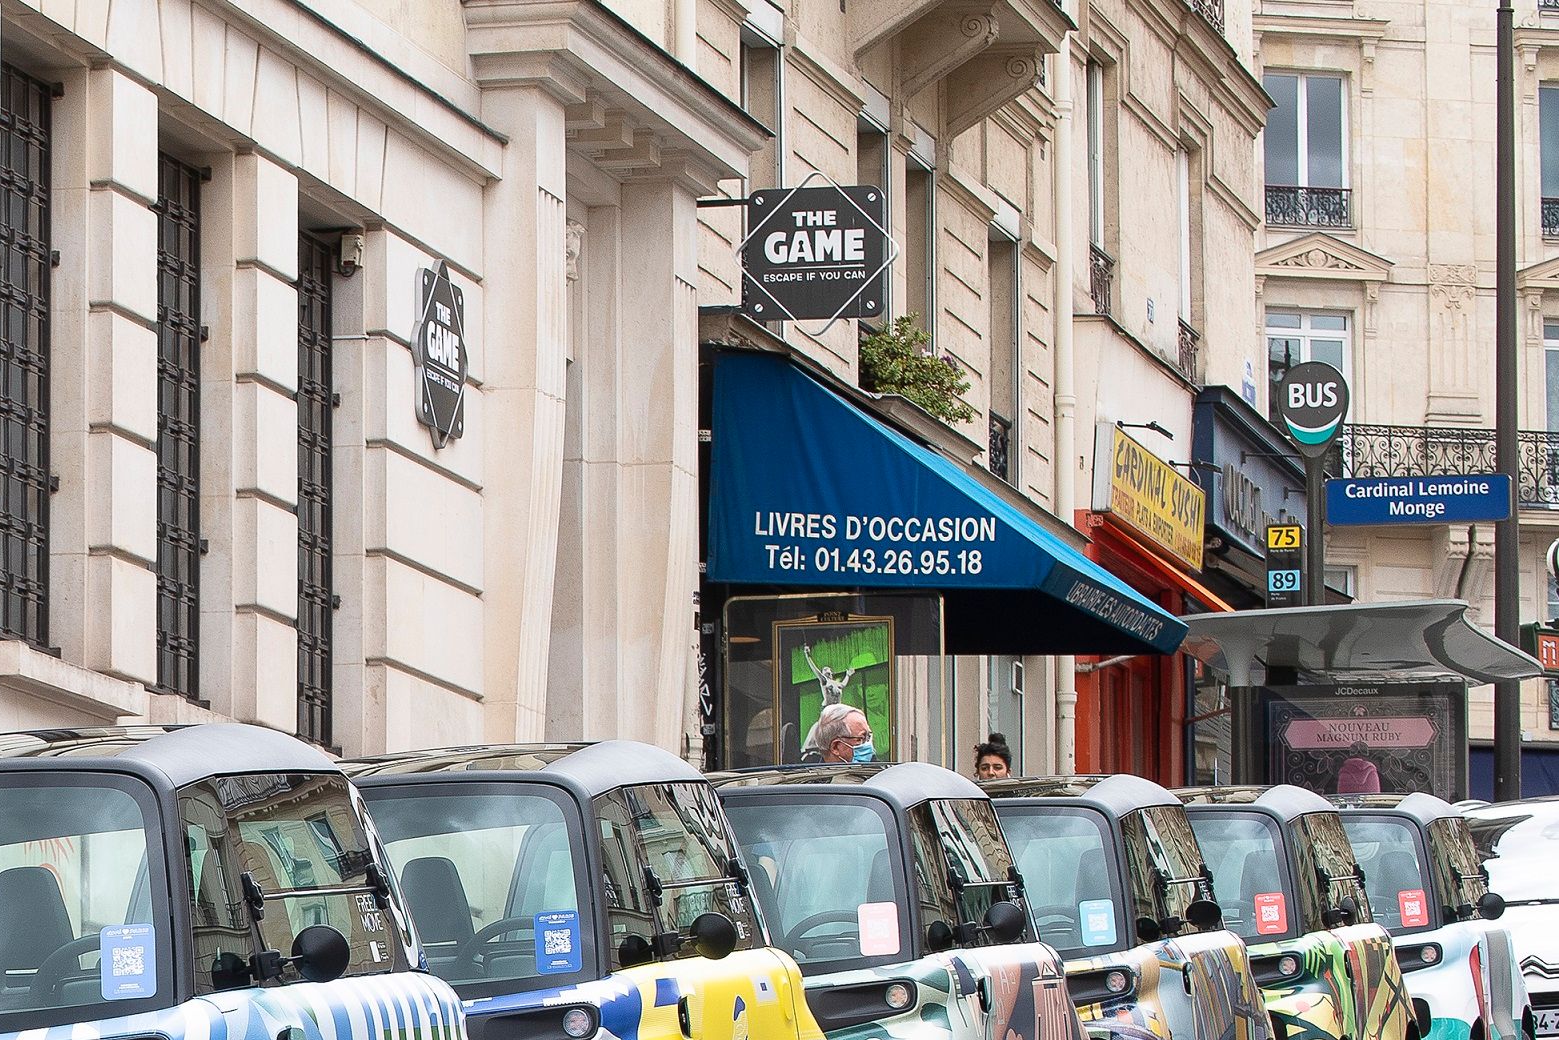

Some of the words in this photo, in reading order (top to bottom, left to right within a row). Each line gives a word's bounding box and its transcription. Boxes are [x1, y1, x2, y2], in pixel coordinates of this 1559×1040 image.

[792, 210, 836, 227] THE
[764, 229, 865, 264] GAME
[763, 272, 803, 283] ESCAPE
[806, 272, 816, 281] IF
[819, 271, 840, 281] YOU
[844, 270, 866, 280] CAN
[435, 301, 451, 326] THE
[426, 321, 460, 373] GAME
[1288, 381, 1337, 408] BUS
[1115, 438, 1167, 510] CARDINAL
[1171, 478, 1201, 536] SUSHI
[1345, 482, 1413, 498] Cardinal
[1419, 480, 1489, 496] Lemoine
[1389, 494, 1445, 518] Monge
[755, 511, 837, 539] LIVRES
[845, 516, 996, 542] D'OCCASION
[1271, 529, 1296, 546] 75
[765, 544, 806, 570] Tél:
[814, 547, 983, 575] 01.43.26.95.18
[1272, 572, 1296, 589] 89
[1335, 687, 1379, 696] JCDecaux
[1316, 732, 1369, 742] MAGNUM
[1372, 732, 1402, 741] RUBY
[1329, 722, 1390, 733] NOUVEAU
